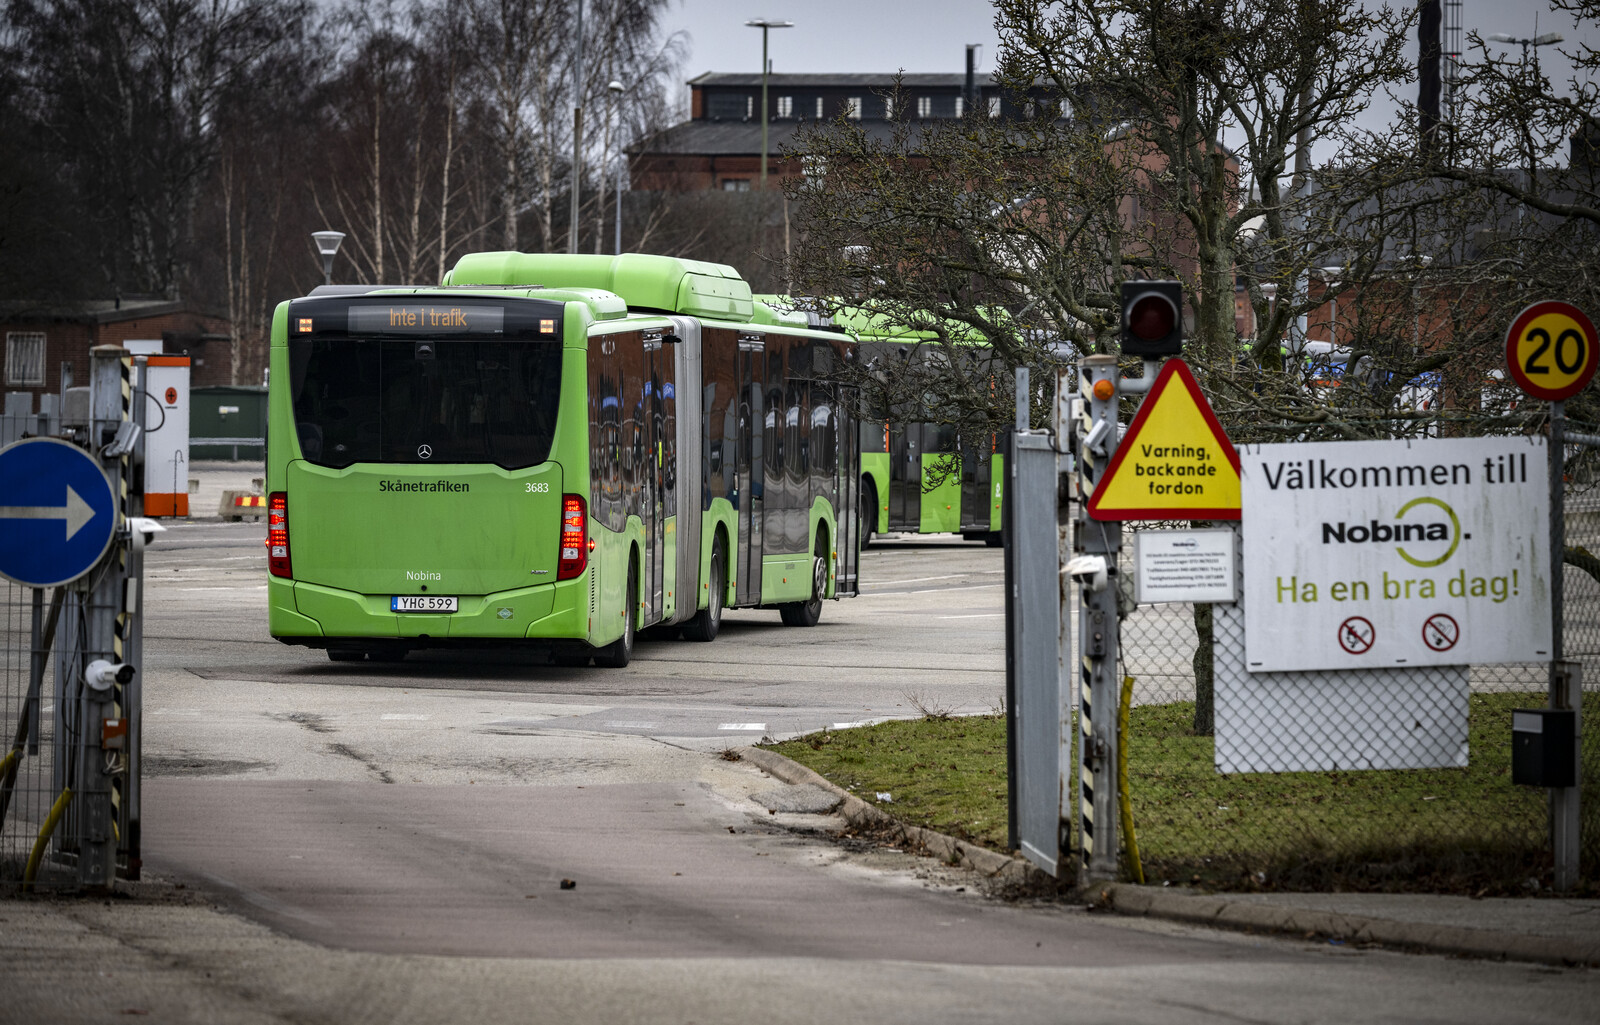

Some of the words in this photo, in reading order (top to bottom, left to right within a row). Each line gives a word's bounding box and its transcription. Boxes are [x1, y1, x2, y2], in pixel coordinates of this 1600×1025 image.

[390, 308, 417, 327] Inte
[421, 308, 425, 327] i
[429, 307, 468, 327] trafik
[1525, 327, 1586, 375] 20
[1141, 444, 1211, 461] Varning,
[1135, 462, 1217, 476] backande
[1261, 459, 1471, 490] Välkommen
[1483, 453, 1527, 484] till
[379, 480, 470, 493] Skånetrafiken
[525, 482, 550, 493] 3683
[1148, 481, 1204, 495] fordon
[406, 570, 442, 581] Nobina
[1276, 576, 1319, 603] Ha
[1330, 580, 1370, 602] en
[1382, 571, 1436, 600] bra
[1447, 568, 1520, 603] dag!
[401, 597, 425, 609] YHG
[428, 597, 453, 609] 599
